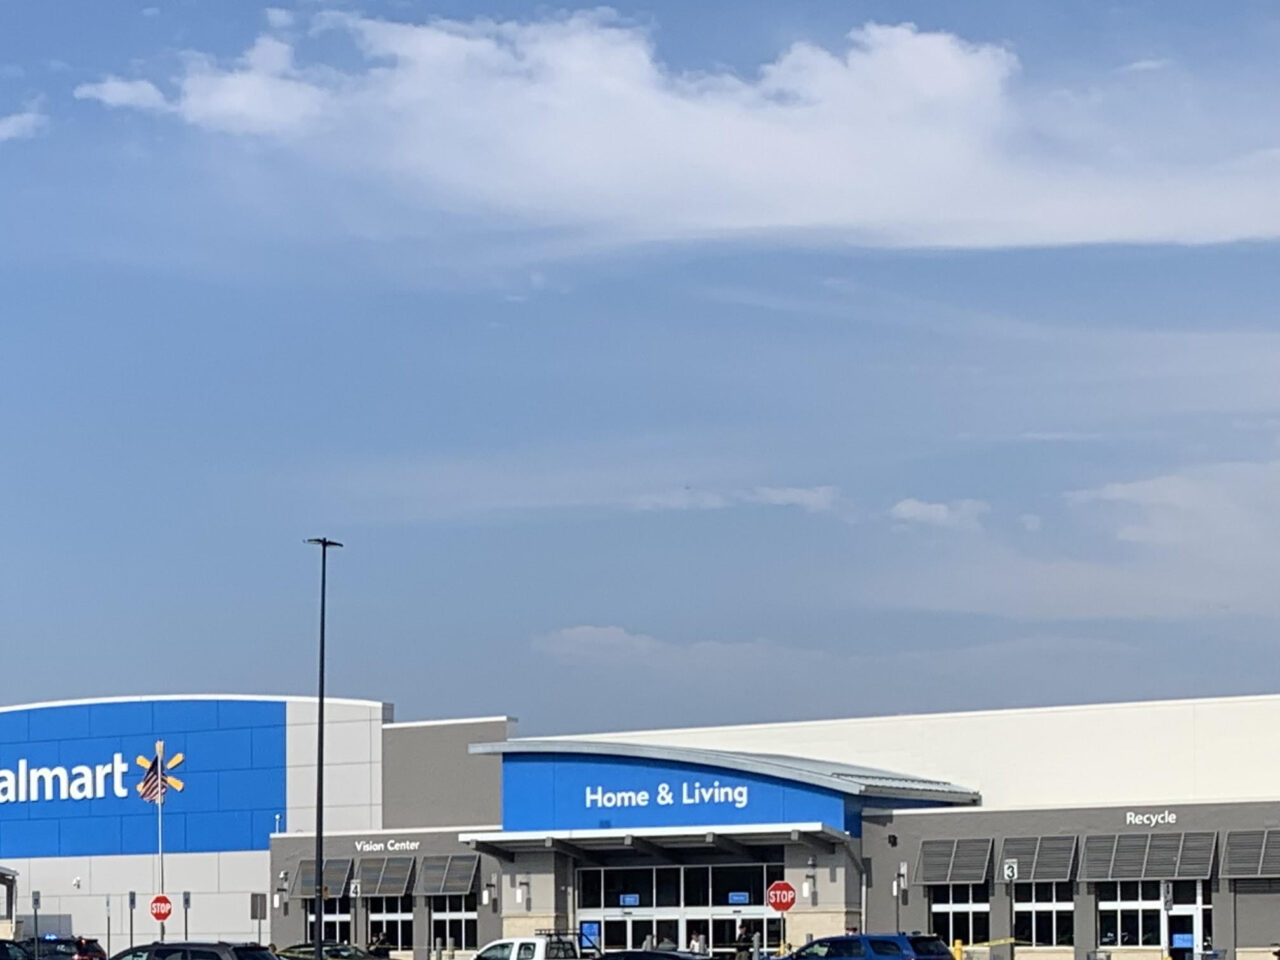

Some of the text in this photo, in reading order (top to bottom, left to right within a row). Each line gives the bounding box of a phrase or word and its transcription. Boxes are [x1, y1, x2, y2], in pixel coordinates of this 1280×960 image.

[585, 781, 748, 808] Home & Living
[1126, 811, 1177, 827] Recycle
[355, 840, 420, 851] Vision Center
[1006, 865, 1015, 879] 3
[770, 891, 795, 902] STOP
[152, 903, 170, 913] STOP
